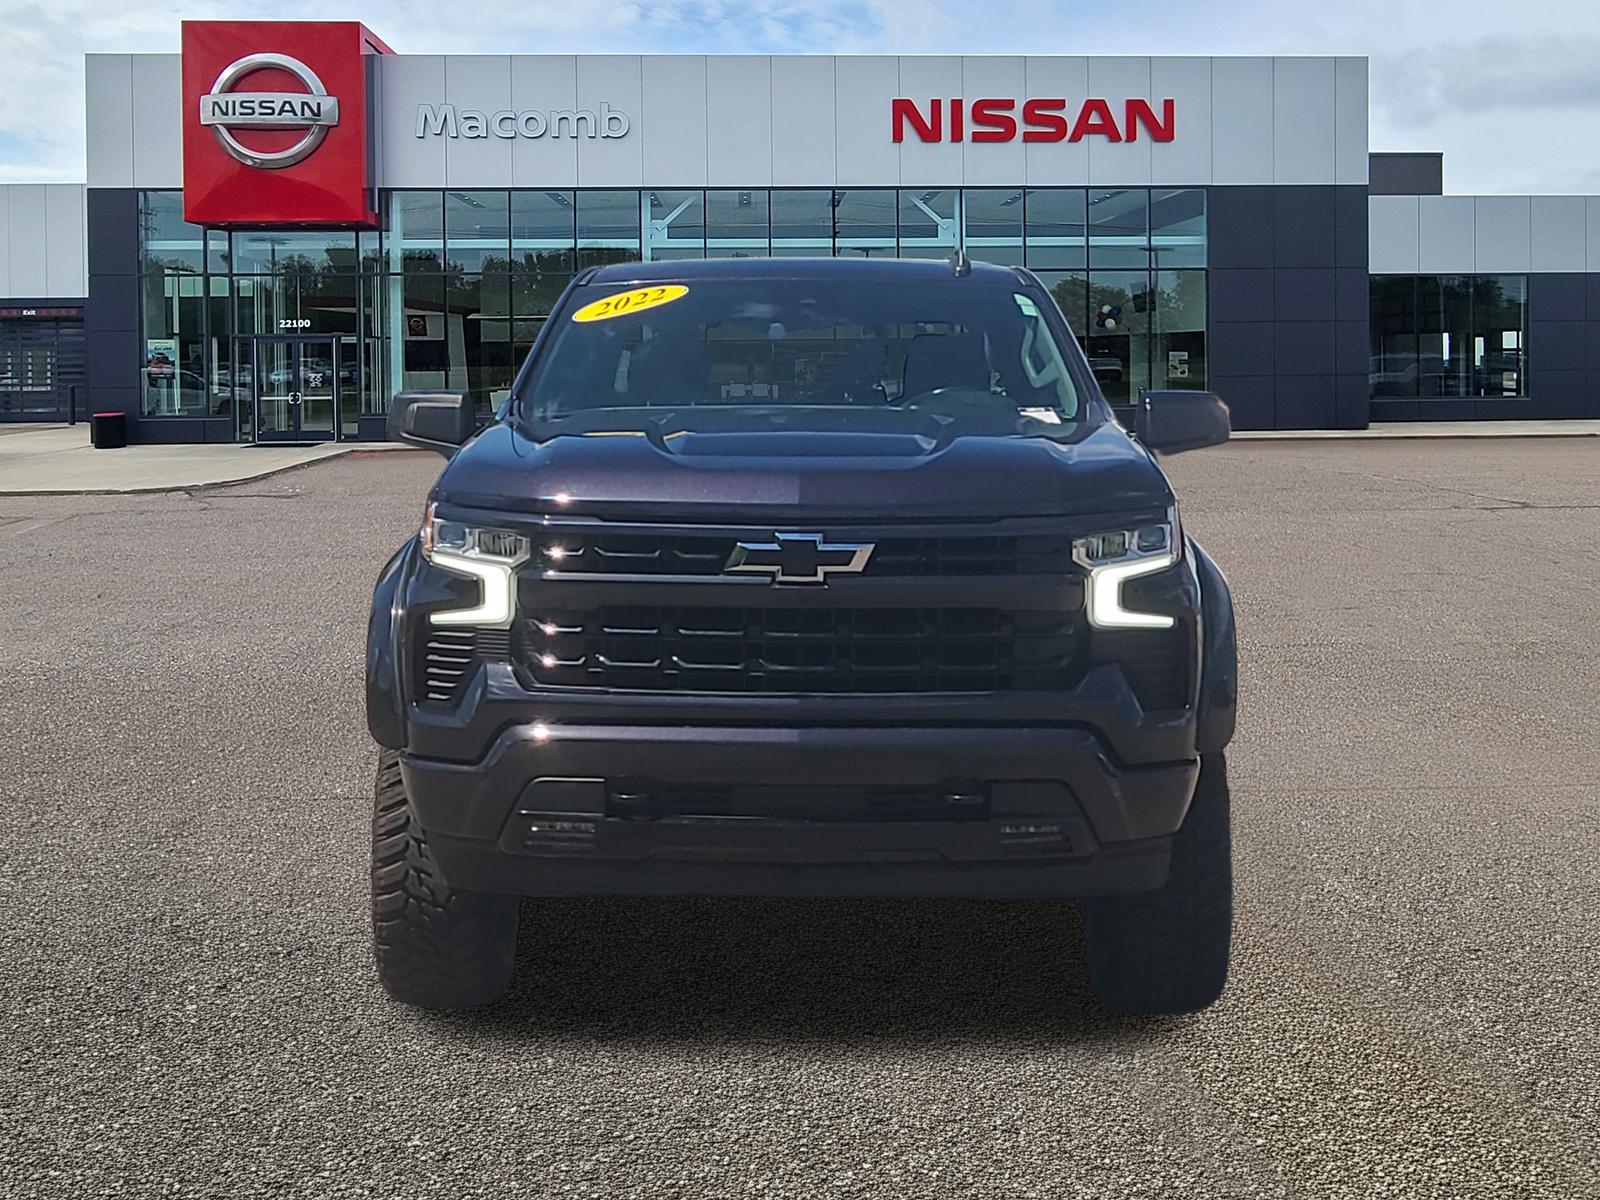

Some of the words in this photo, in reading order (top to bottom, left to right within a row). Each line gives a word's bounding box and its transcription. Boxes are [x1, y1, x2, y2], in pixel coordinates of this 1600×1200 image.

[212, 100, 322, 118] NISSAN
[415, 102, 630, 138] Macomb
[892, 98, 1175, 142] NISSAN
[595, 288, 667, 317] 2022
[279, 319, 311, 328] 22100
